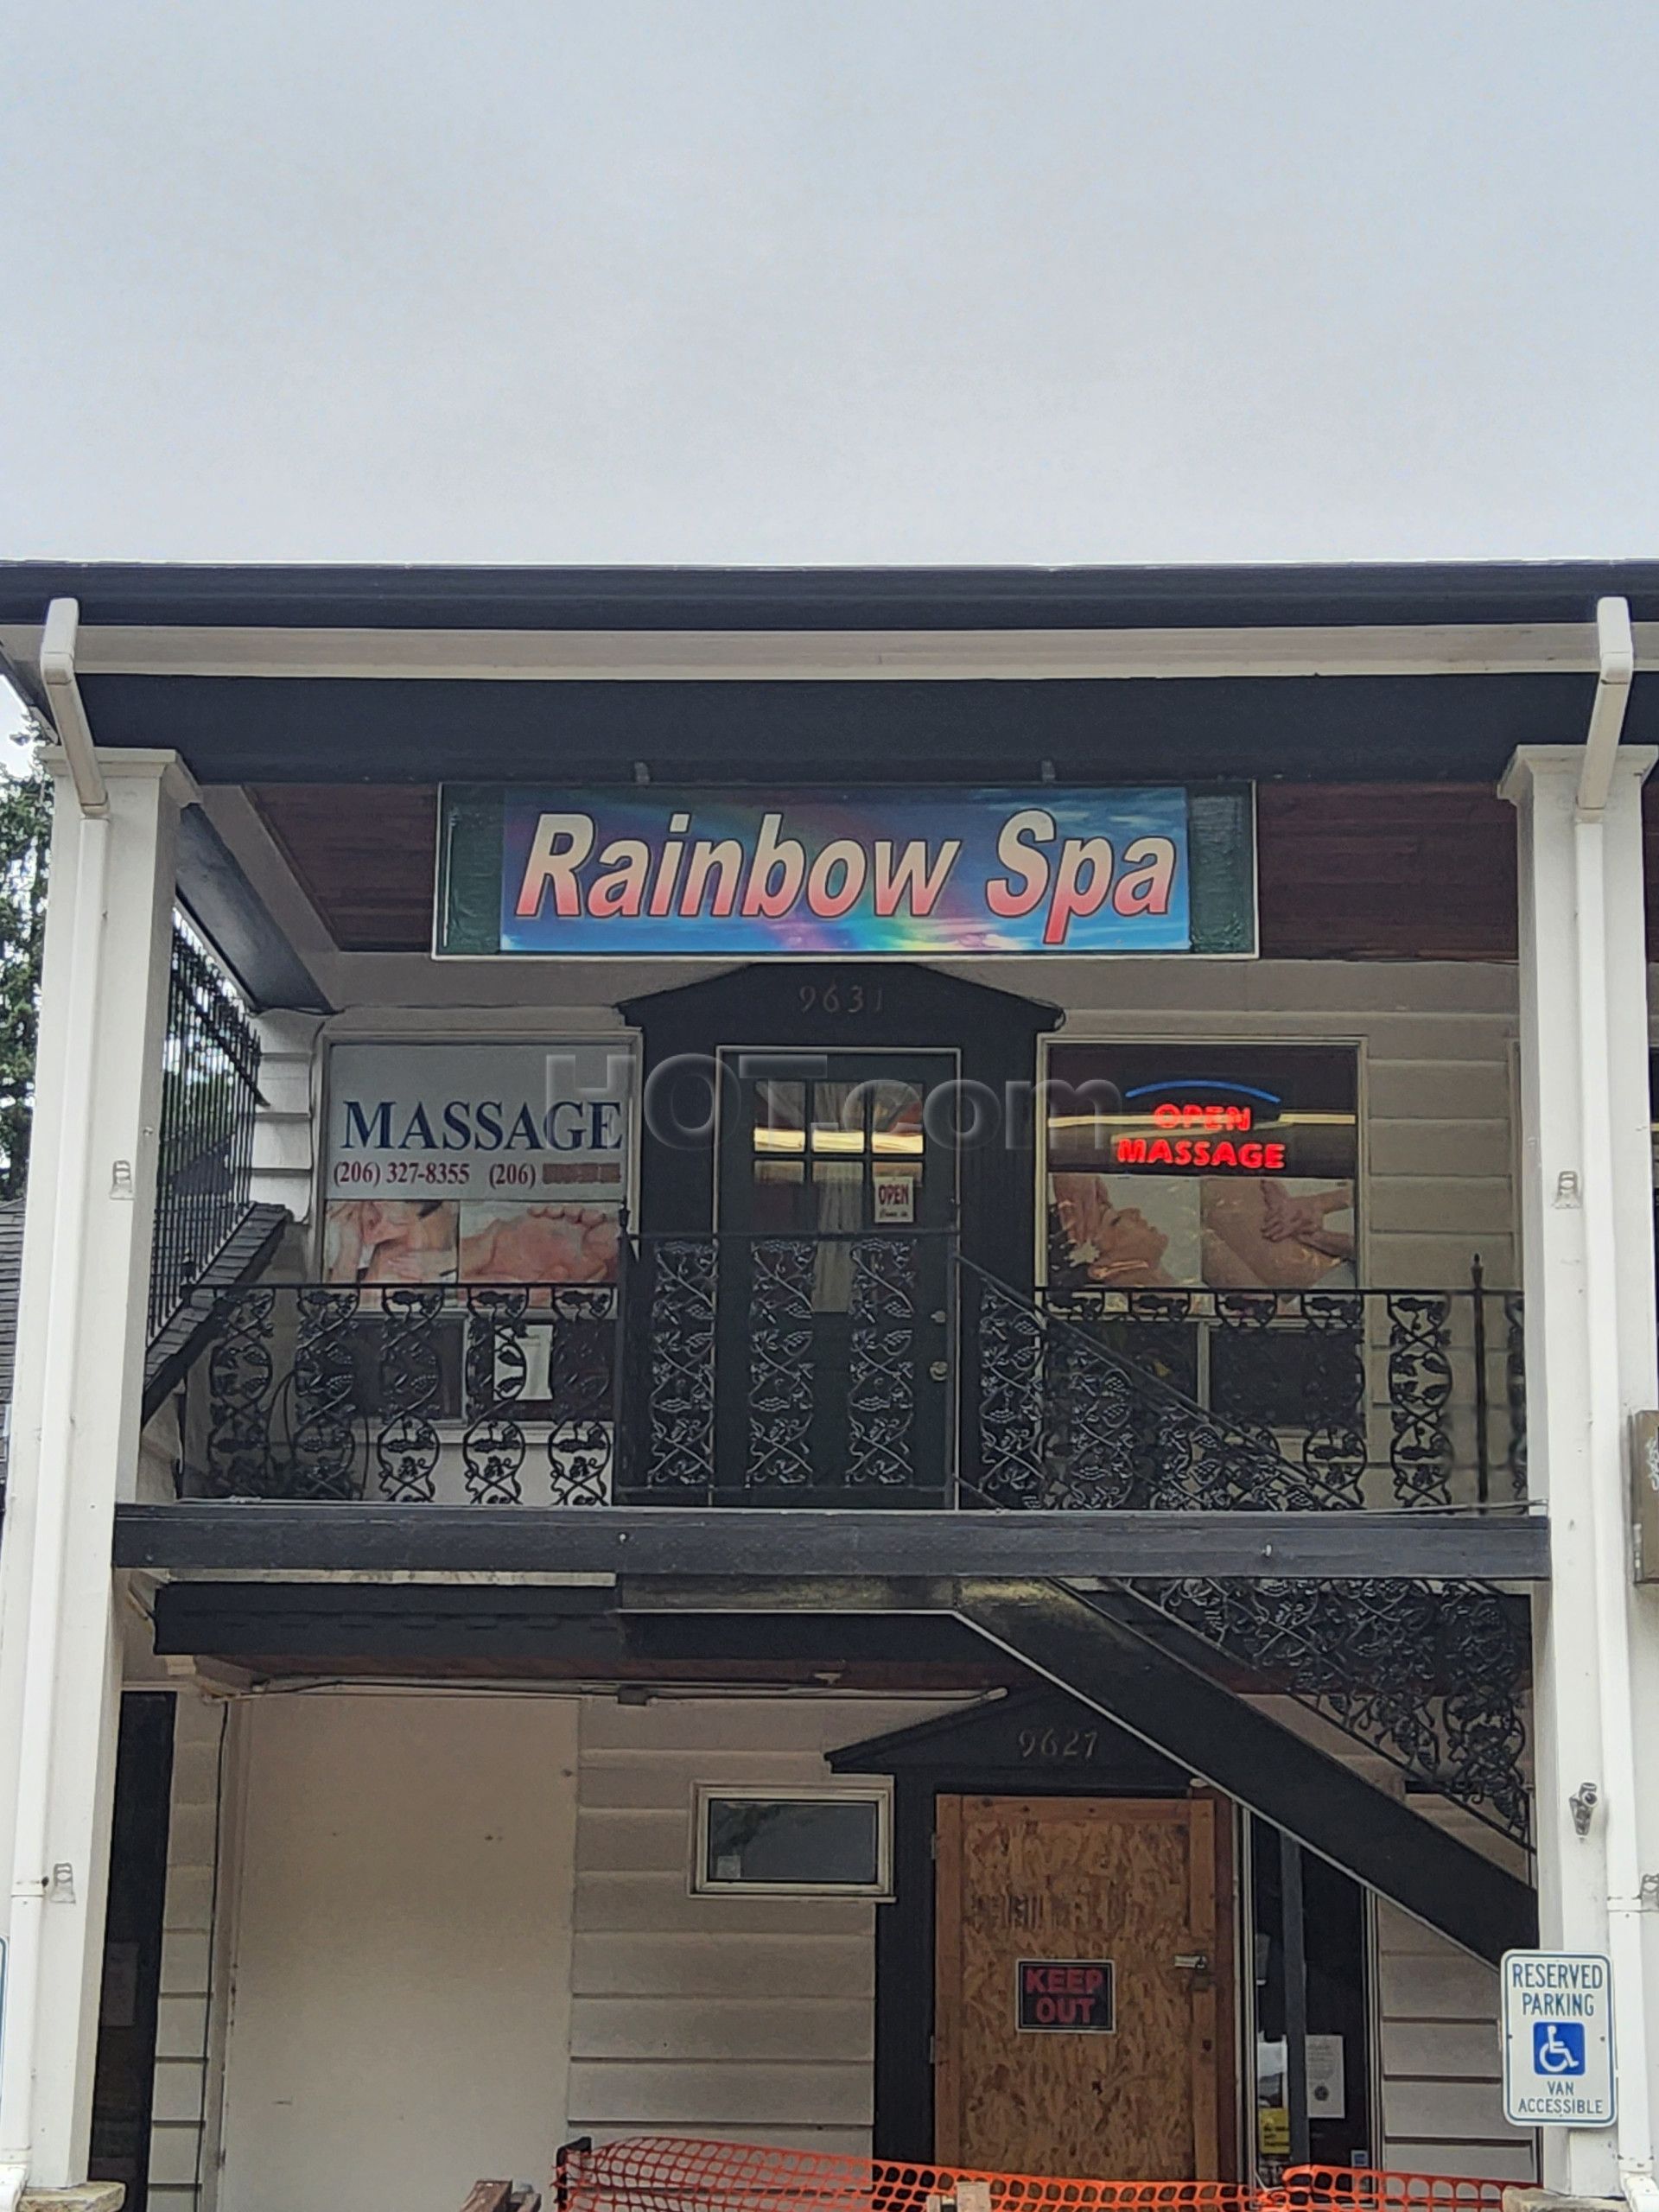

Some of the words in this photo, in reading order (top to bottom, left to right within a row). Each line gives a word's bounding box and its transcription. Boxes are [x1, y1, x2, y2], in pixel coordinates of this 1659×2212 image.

[516, 812, 961, 918] Rainbow
[985, 809, 1177, 944] Spa
[799, 981, 882, 1014] 9631
[340, 1101, 623, 1151] MASSAGE
[1153, 1103, 1251, 1131] OPEN
[1116, 1138, 1286, 1169] MASSAGE
[334, 1160, 381, 1187] (206)
[386, 1160, 470, 1185] 327-8355
[489, 1161, 536, 1190] (206)
[878, 1184, 909, 1205] OPEN
[1019, 1728, 1097, 1758] 9627
[1026, 1968, 1103, 1994] KEEP
[1512, 1963, 1604, 1989] RESERVED
[1036, 1997, 1096, 2024] OUT
[1522, 1993, 1595, 2017] PARKING
[1547, 2081, 1574, 2096] VAN
[1517, 2098, 1604, 2114] ACCESSIBLE
